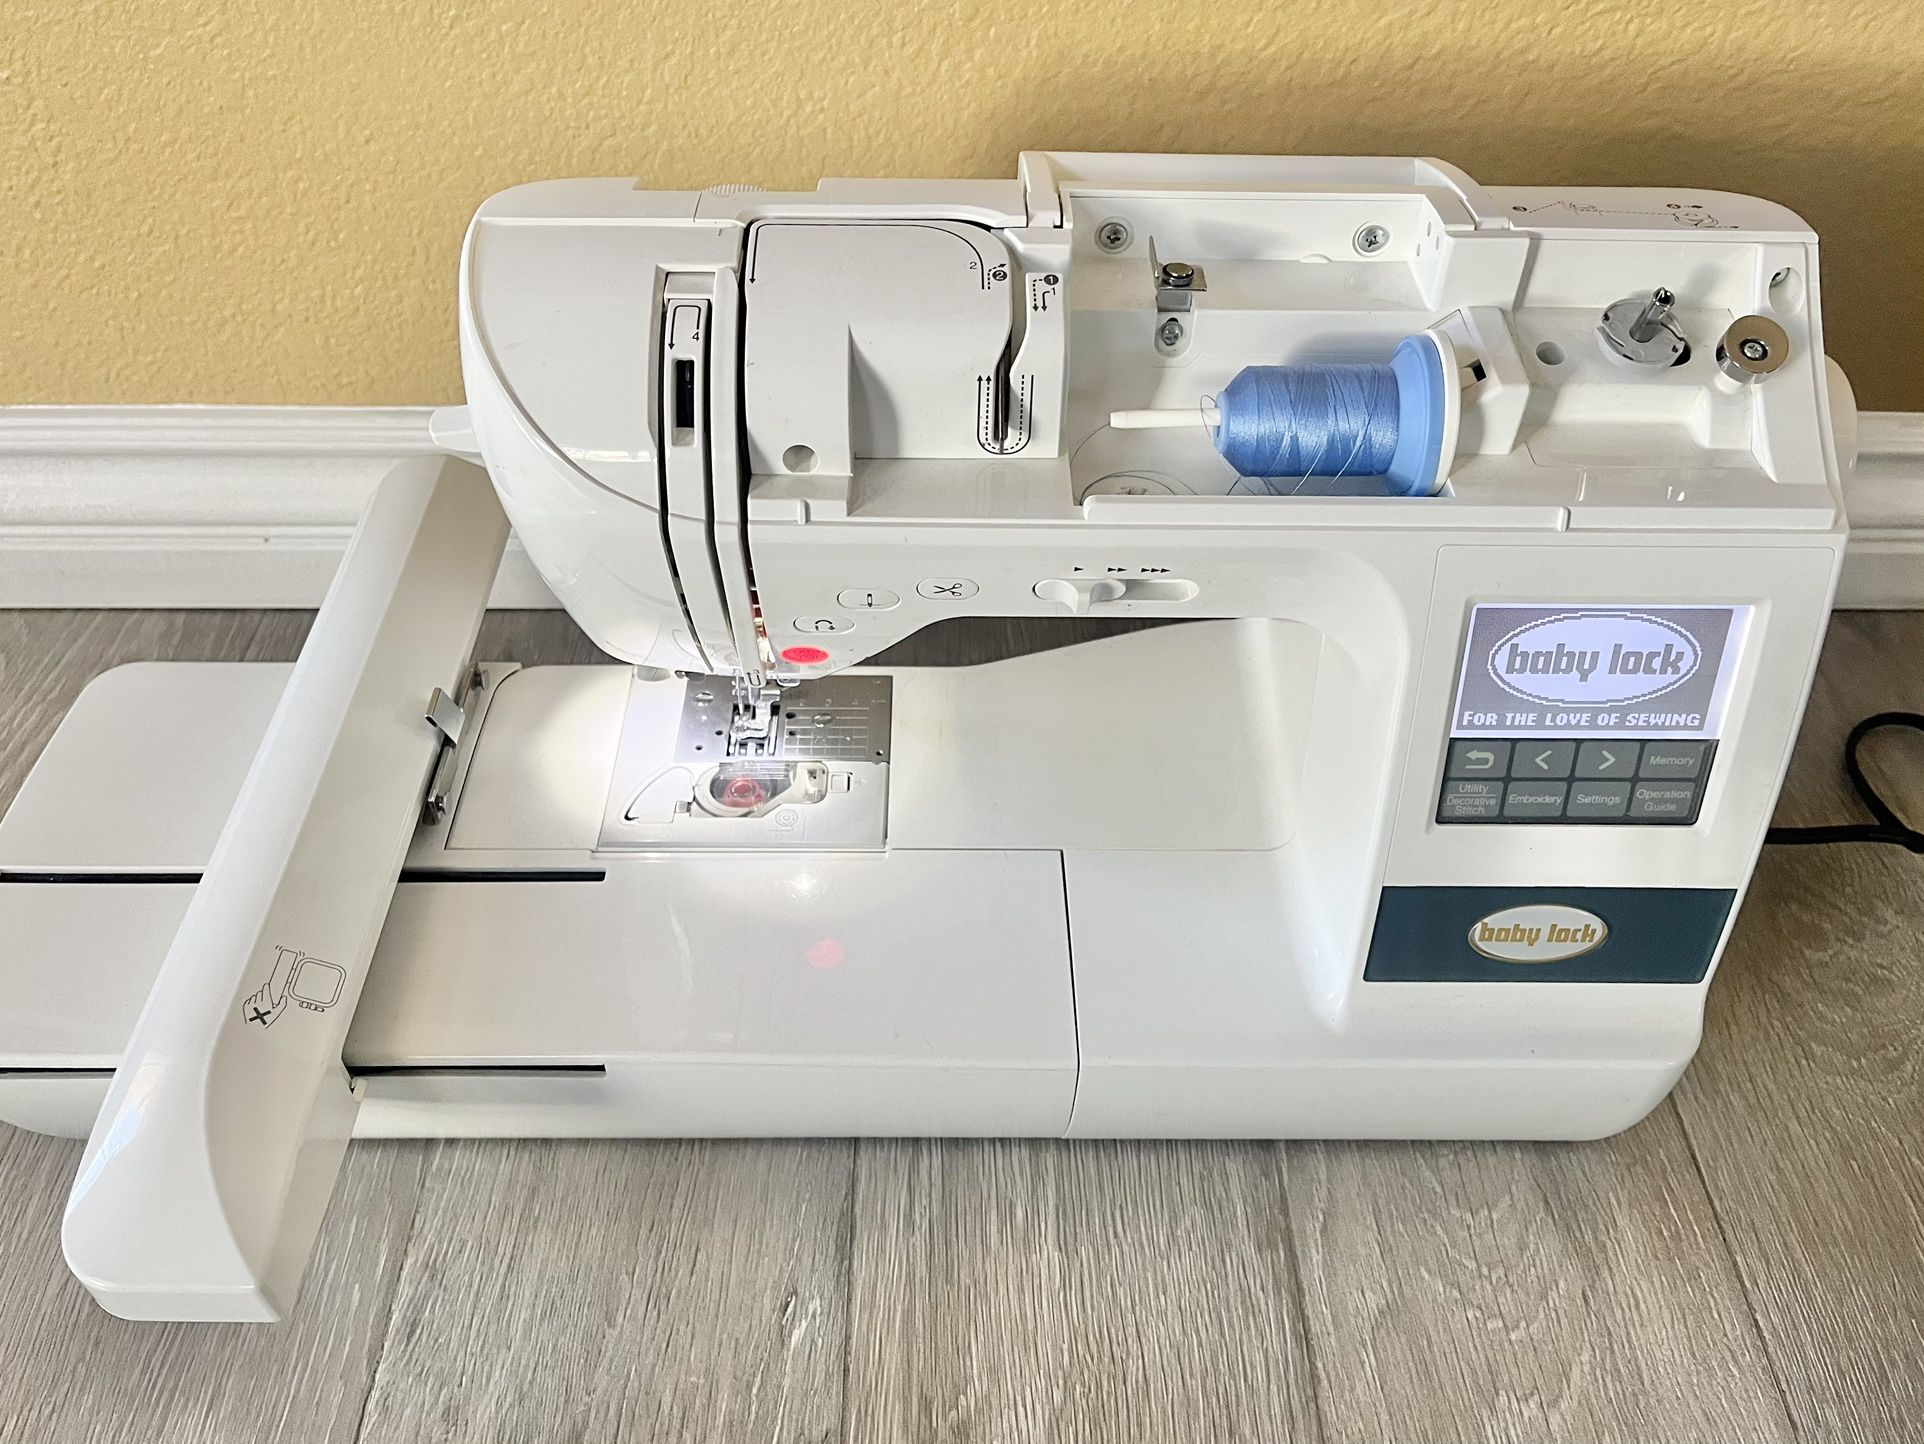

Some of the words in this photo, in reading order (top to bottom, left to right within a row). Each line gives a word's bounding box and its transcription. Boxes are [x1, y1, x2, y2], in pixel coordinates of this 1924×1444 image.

[969, 261, 977, 270] 2
[692, 331, 700, 342] 4
[1505, 643, 1600, 682] baby
[1608, 643, 1685, 675] lock
[1462, 711, 1498, 726] FOR
[1505, 712, 1537, 726] THE
[1545, 712, 1591, 726] LOVE
[1597, 712, 1620, 726] OF
[1625, 712, 1701, 727] SEWING
[1649, 755, 1695, 767] Memory
[1459, 783, 1489, 796] Utility
[1636, 788, 1690, 801] Operation
[1446, 796, 1496, 806] Decorative
[1576, 794, 1621, 806] Settings
[1454, 805, 1485, 815] Stitch
[1644, 802, 1677, 812] Guide
[1479, 921, 1541, 946] baby
[1547, 923, 1597, 942] lock
